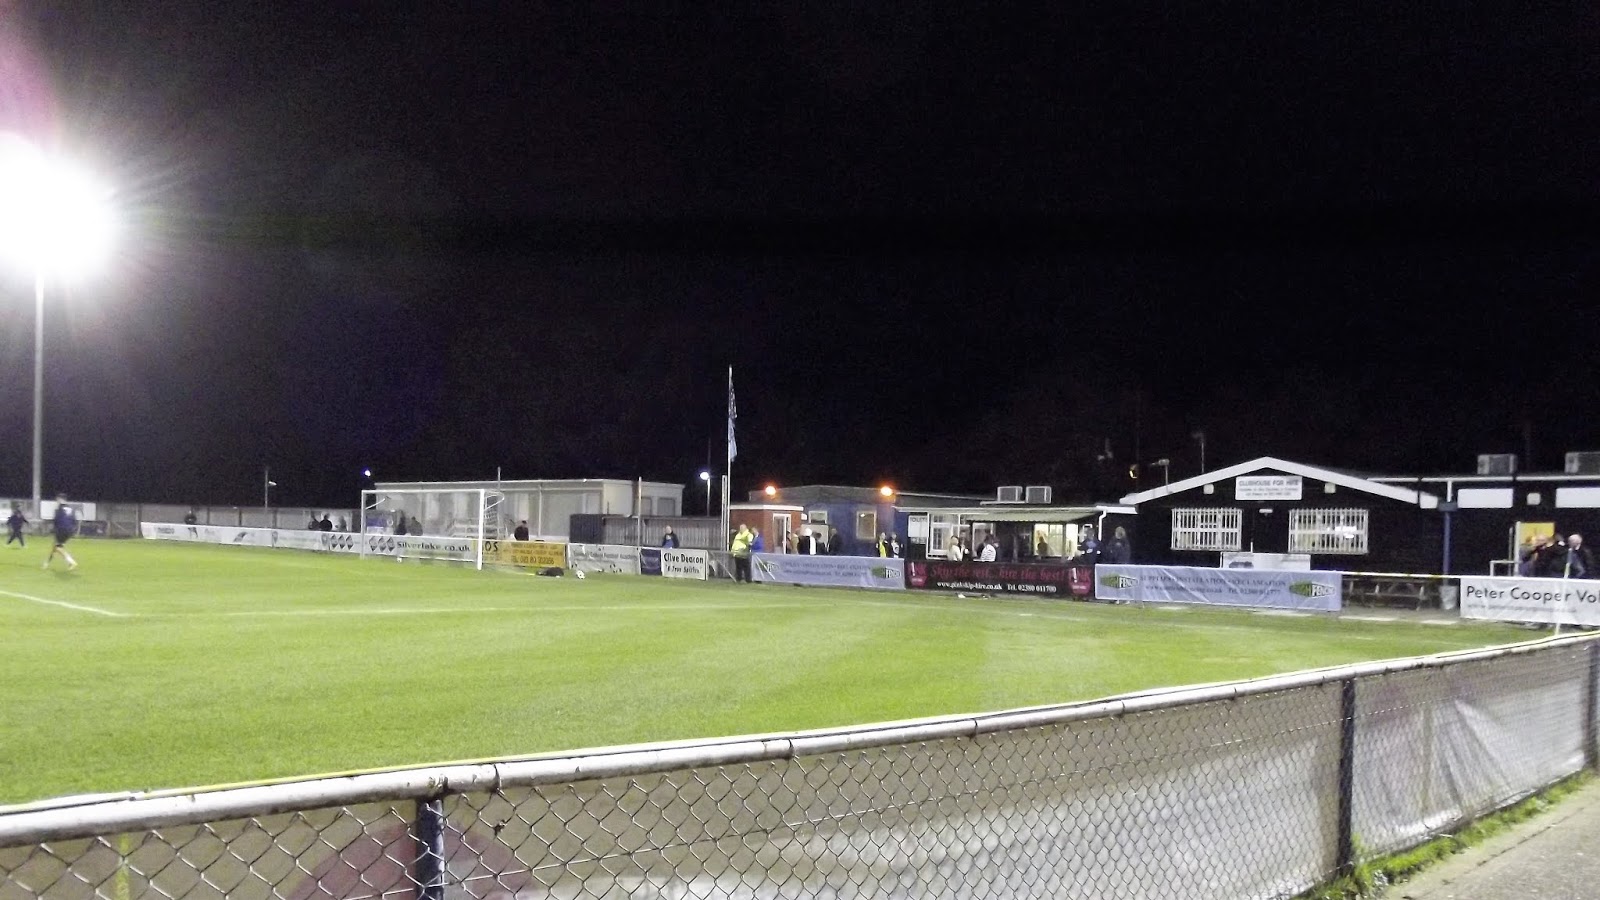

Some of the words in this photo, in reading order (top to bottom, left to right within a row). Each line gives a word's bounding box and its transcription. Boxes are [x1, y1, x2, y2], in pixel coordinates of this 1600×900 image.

[663, 552, 680, 563] Clive
[680, 553, 704, 564] Deacon
[1466, 585, 1504, 599] Peter
[1510, 586, 1571, 604] Cooper
